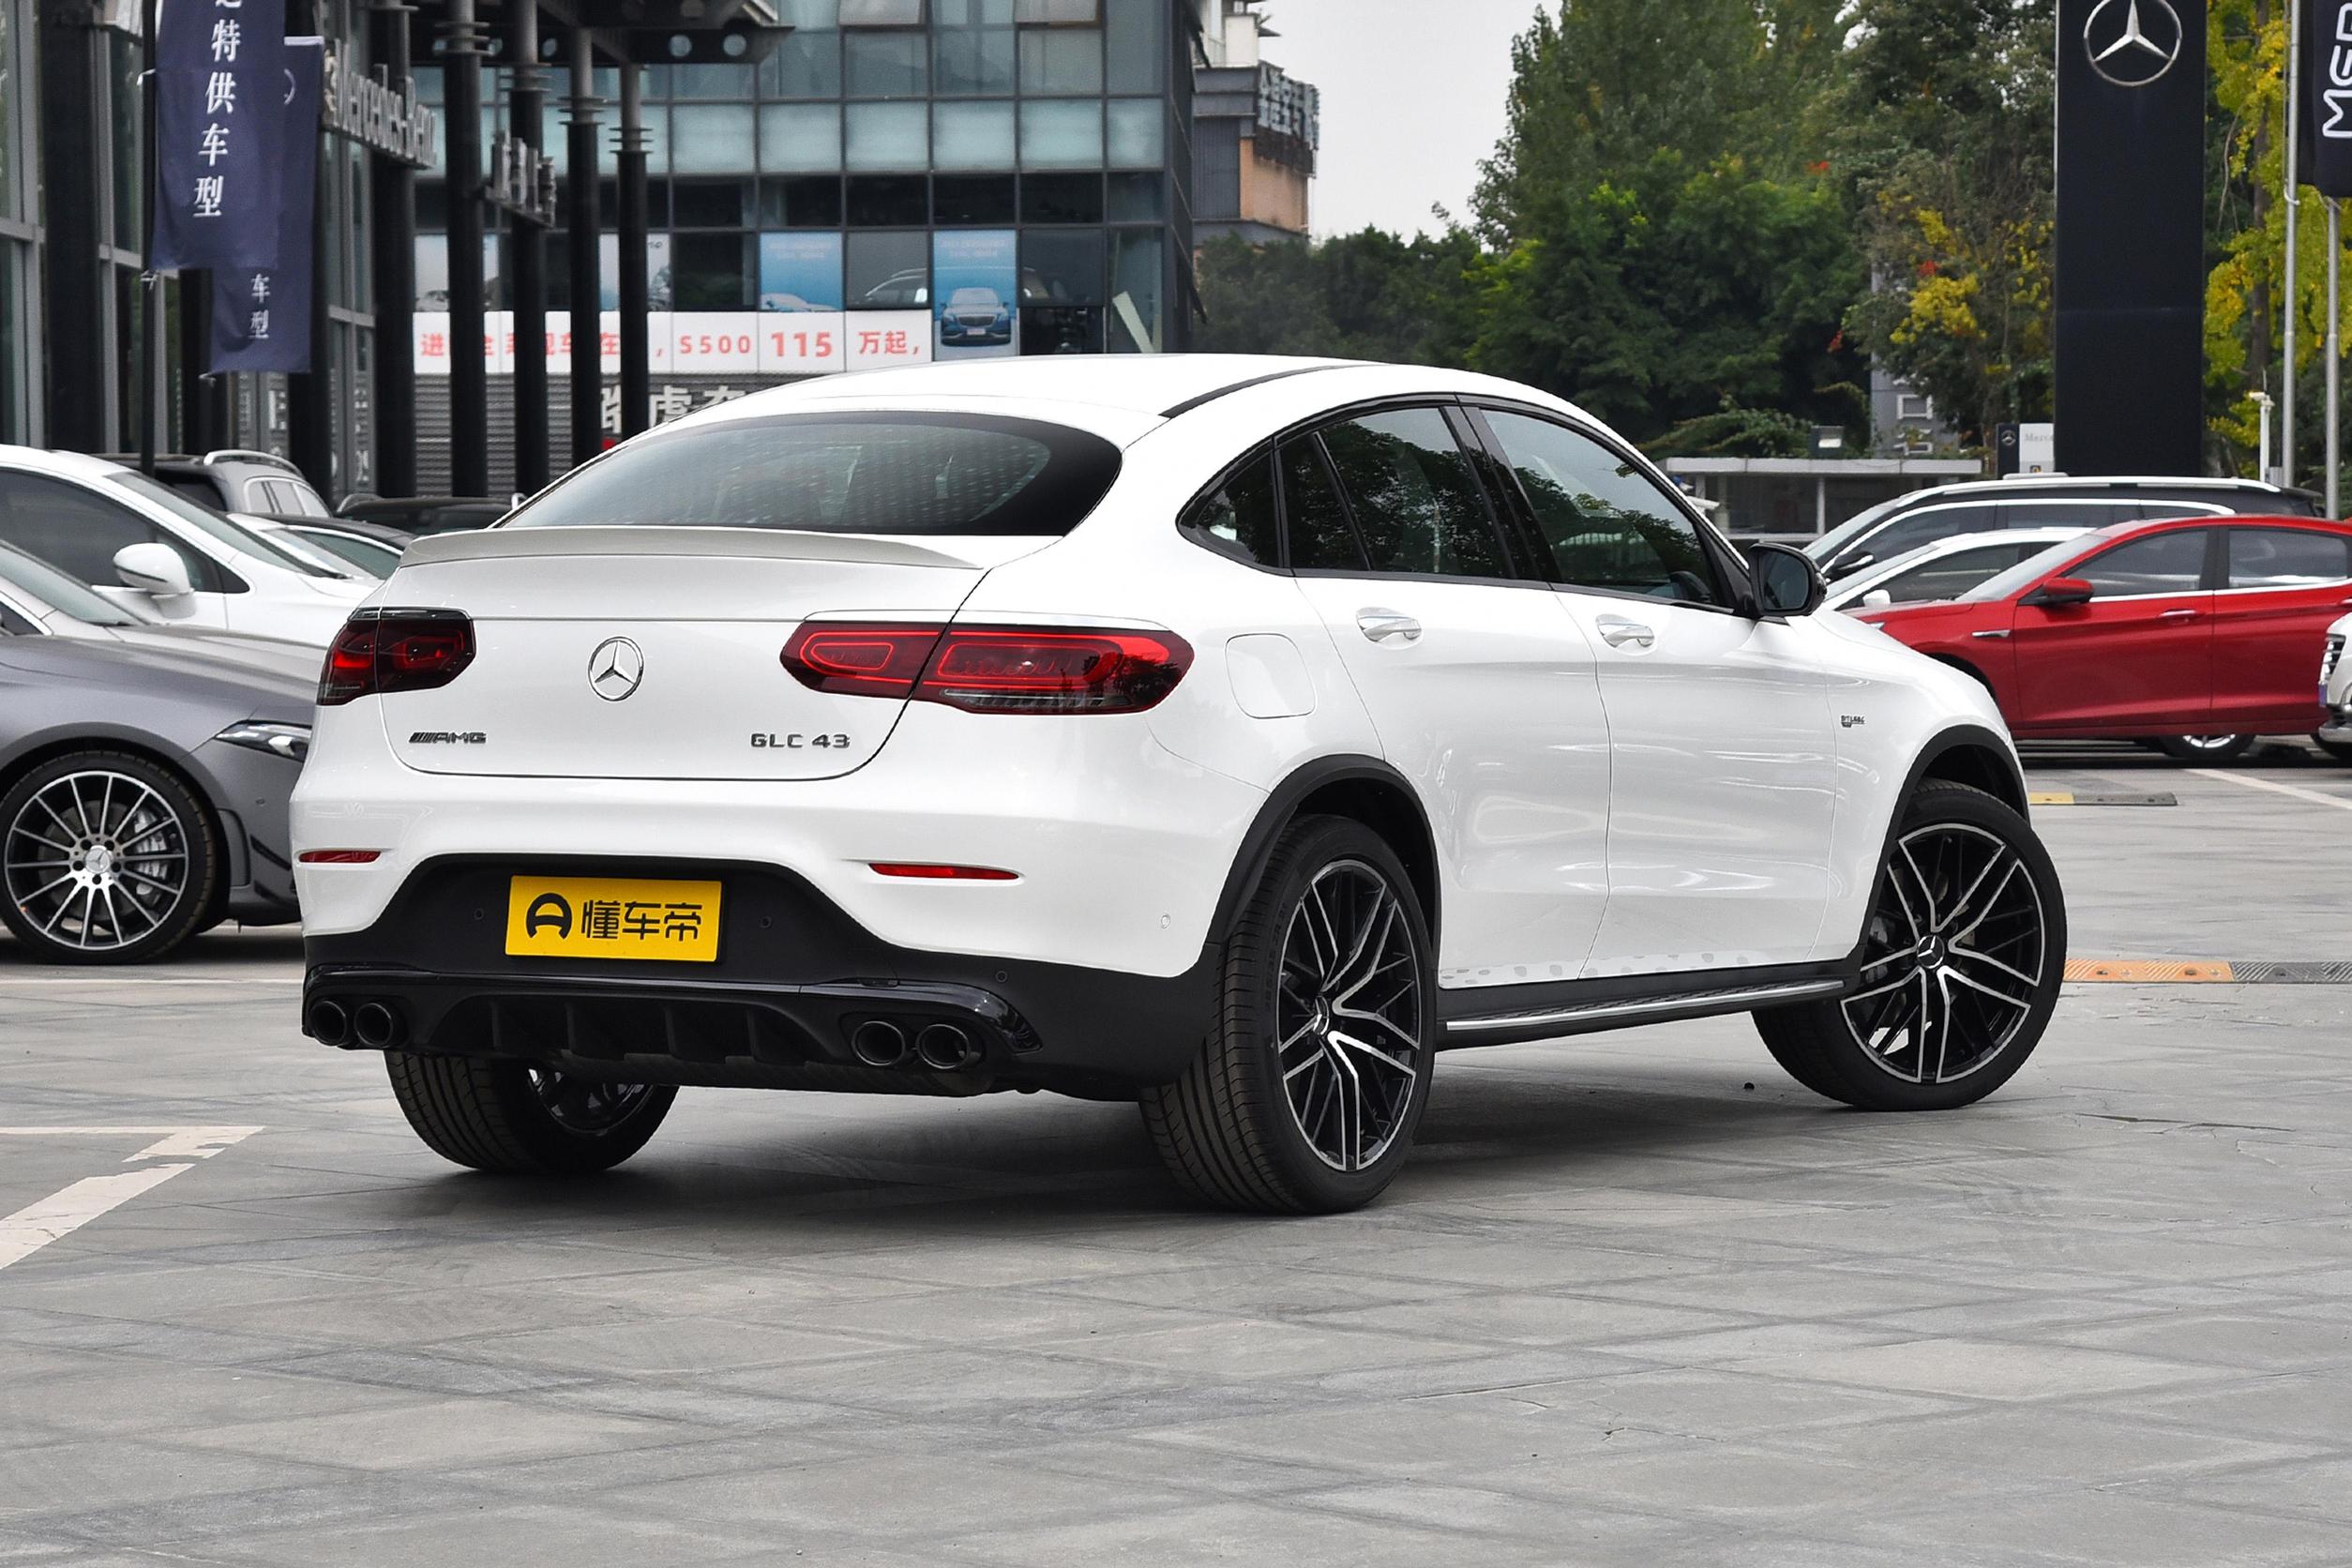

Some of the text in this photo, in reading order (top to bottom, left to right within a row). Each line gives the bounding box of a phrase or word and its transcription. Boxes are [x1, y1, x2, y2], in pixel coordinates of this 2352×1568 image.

[248, 273, 270, 339] 车型
[680, 335, 750, 354] S500
[771, 331, 833, 357] 115
[431, 731, 486, 744] AMG
[750, 733, 851, 749] GLC 43
[580, 898, 703, 942] 懂车帝
